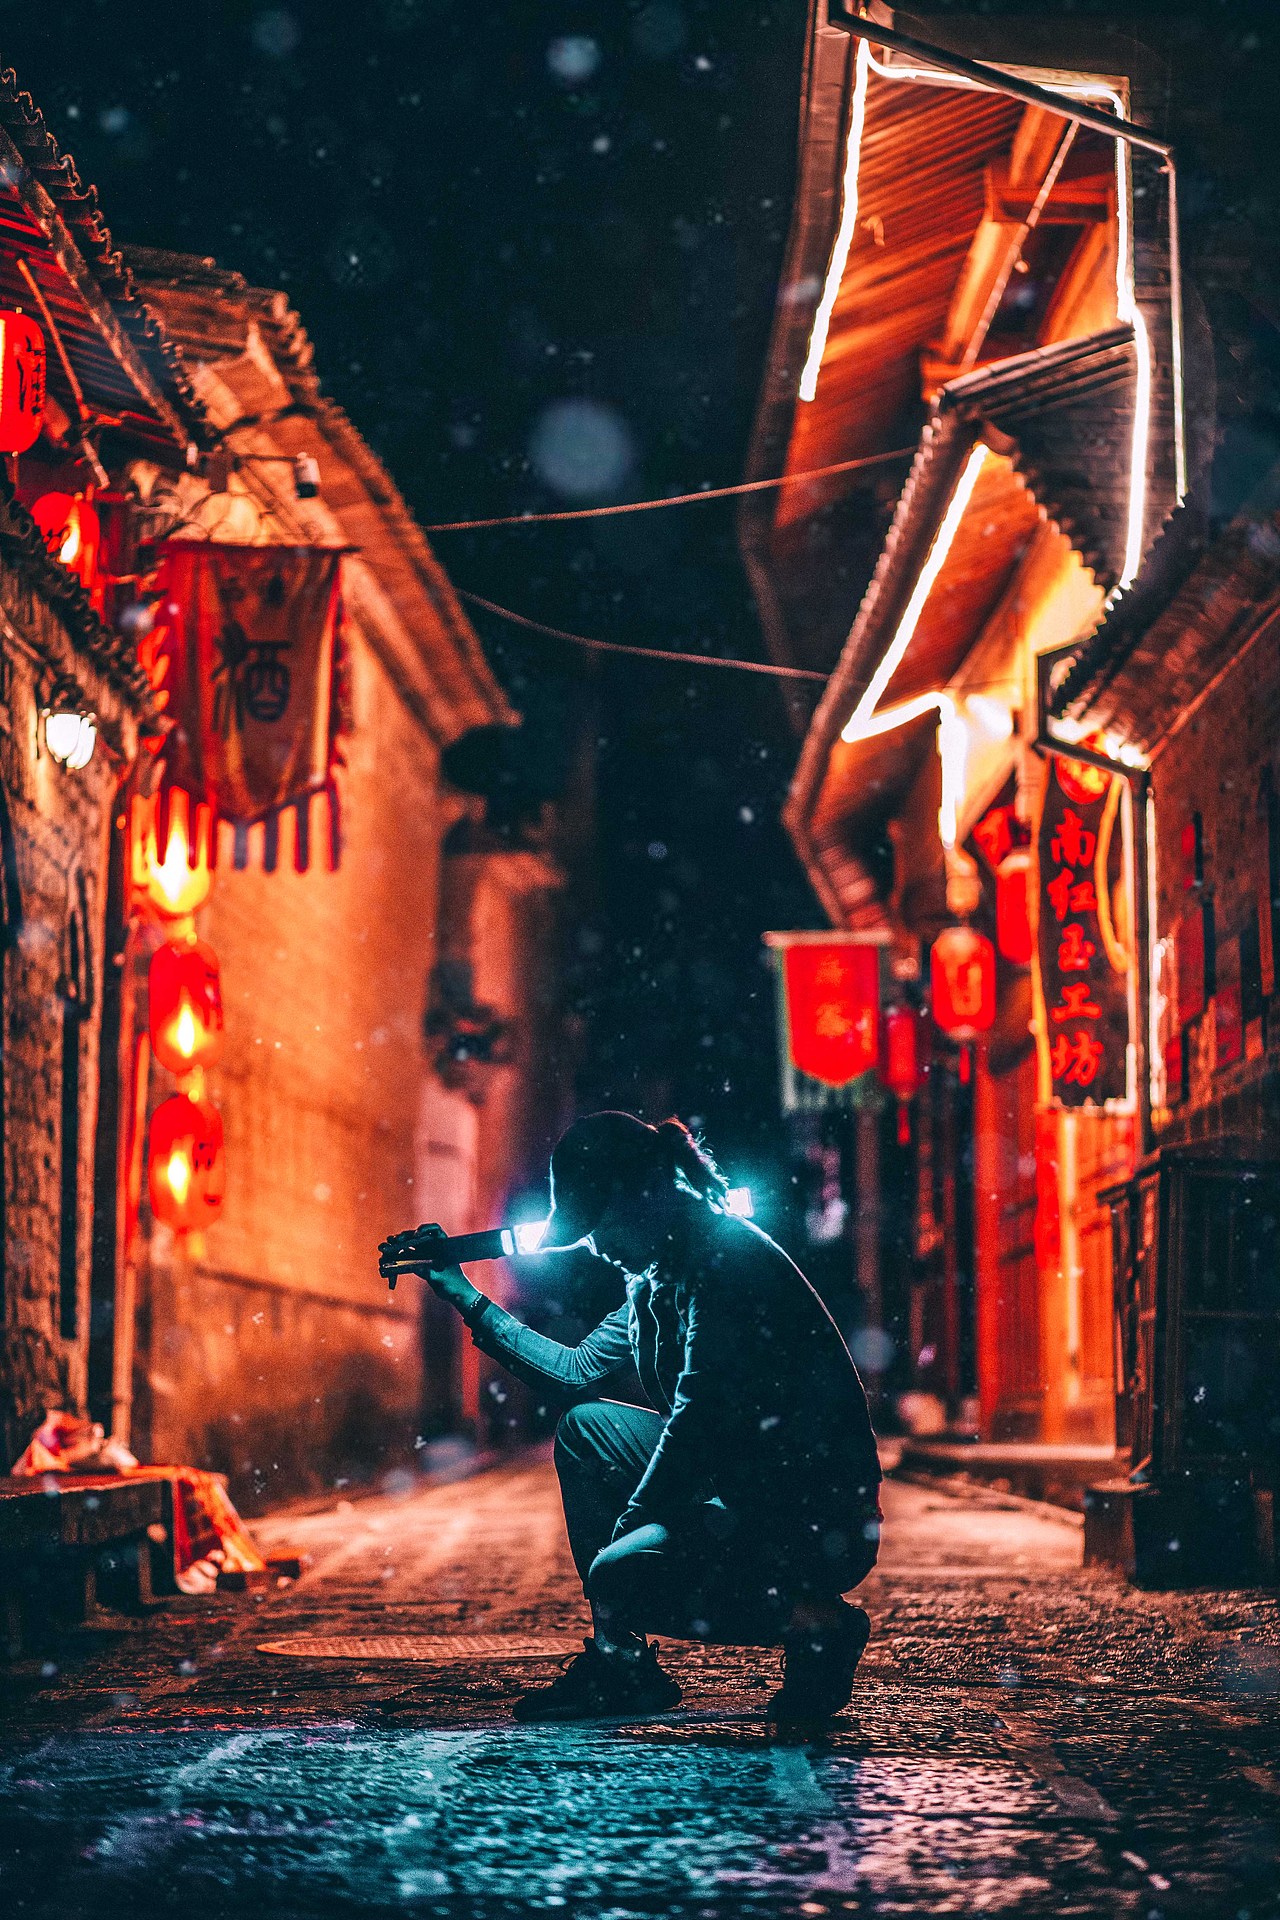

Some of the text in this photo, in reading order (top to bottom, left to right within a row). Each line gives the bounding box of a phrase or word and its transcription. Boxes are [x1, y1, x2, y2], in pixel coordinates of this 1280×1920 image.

[1046, 807, 1104, 1087] 南红玉工坊
